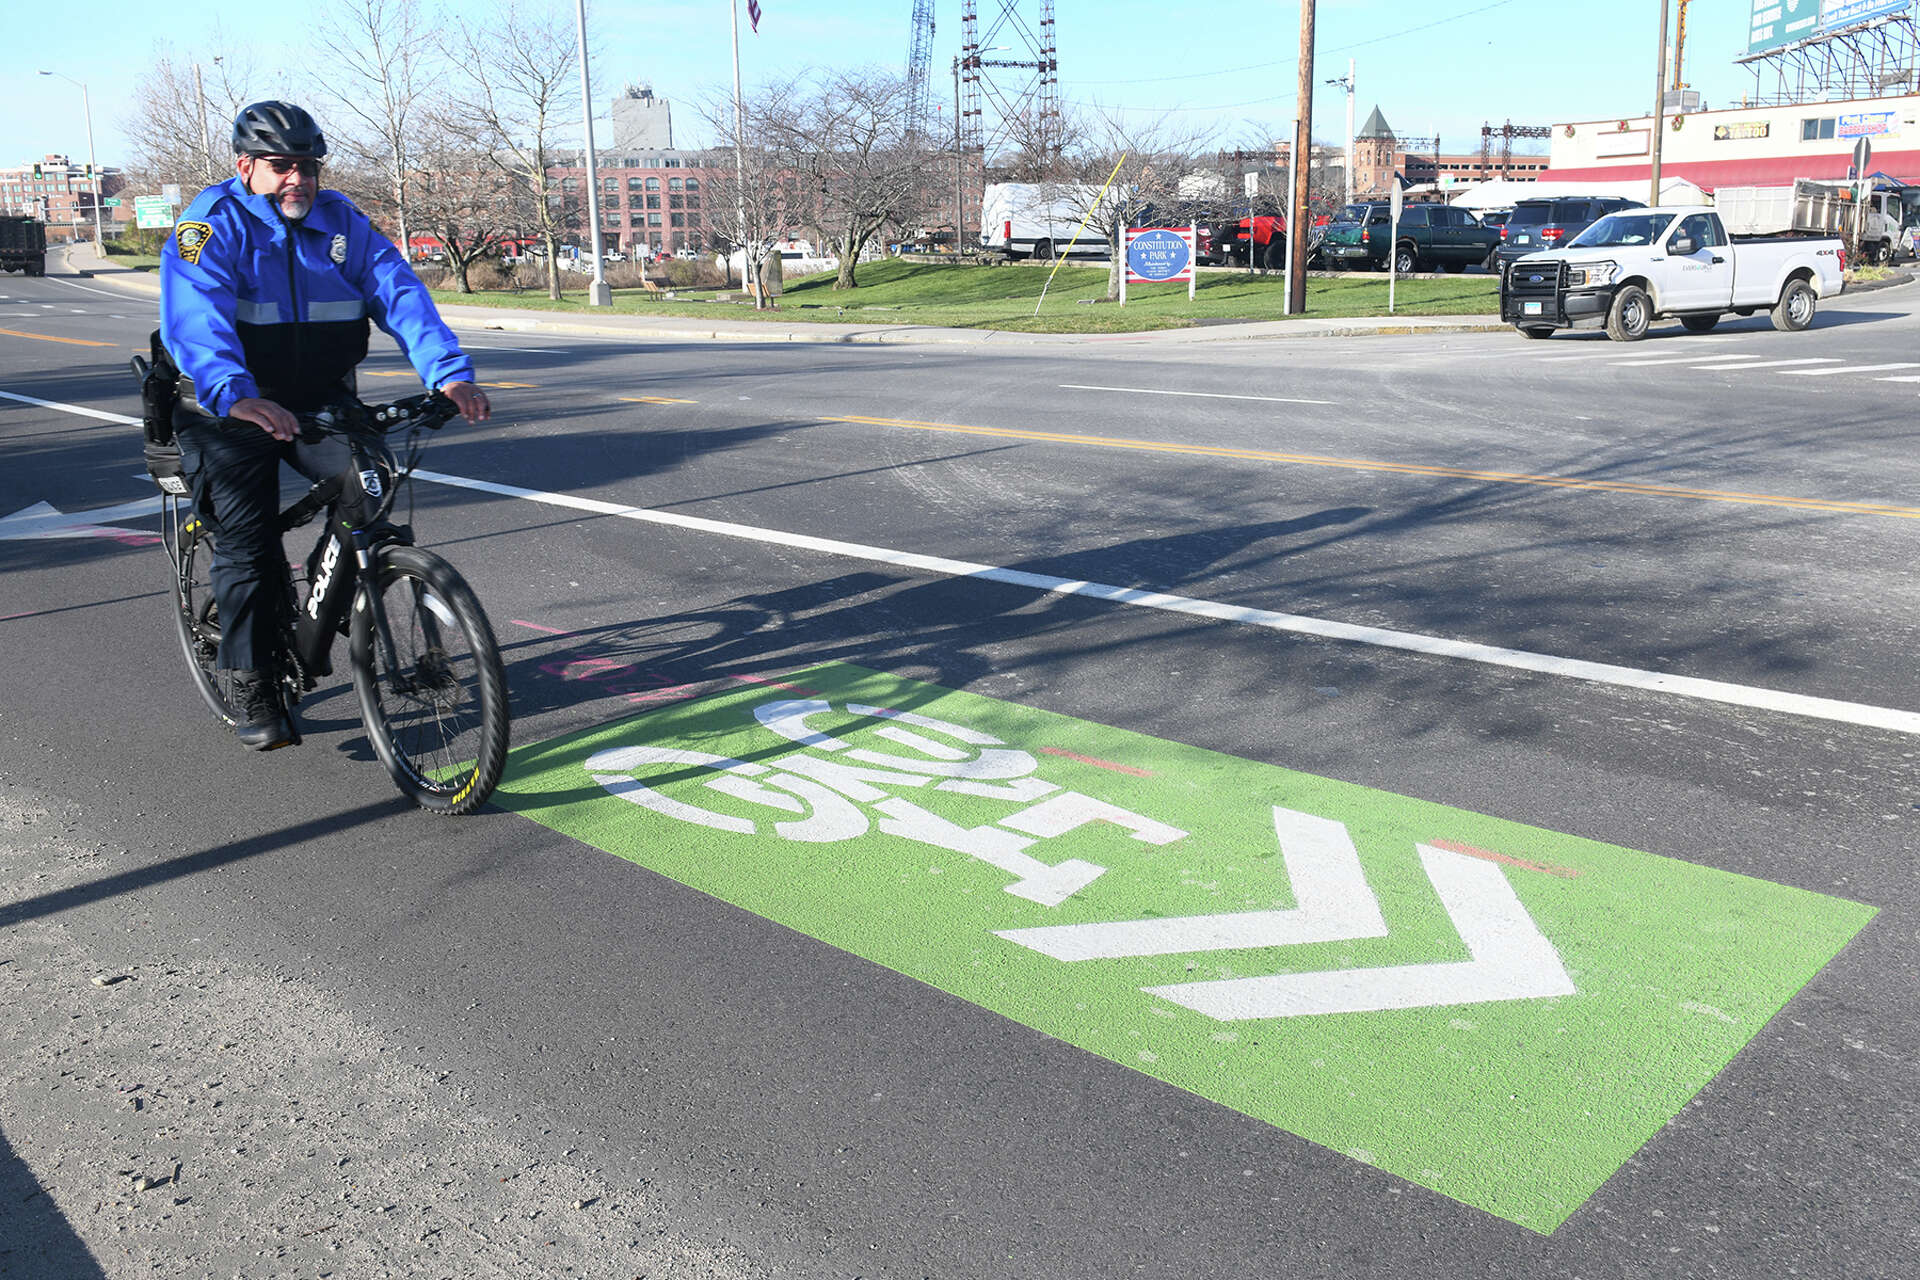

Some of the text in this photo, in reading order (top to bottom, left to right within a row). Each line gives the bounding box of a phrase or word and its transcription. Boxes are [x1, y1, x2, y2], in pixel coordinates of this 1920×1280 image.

[1728, 127, 1767, 139] TATTOO
[1133, 240, 1183, 250] CONSTITUTION
[1149, 251, 1167, 260] PARK
[307, 534, 341, 620] POLICE
